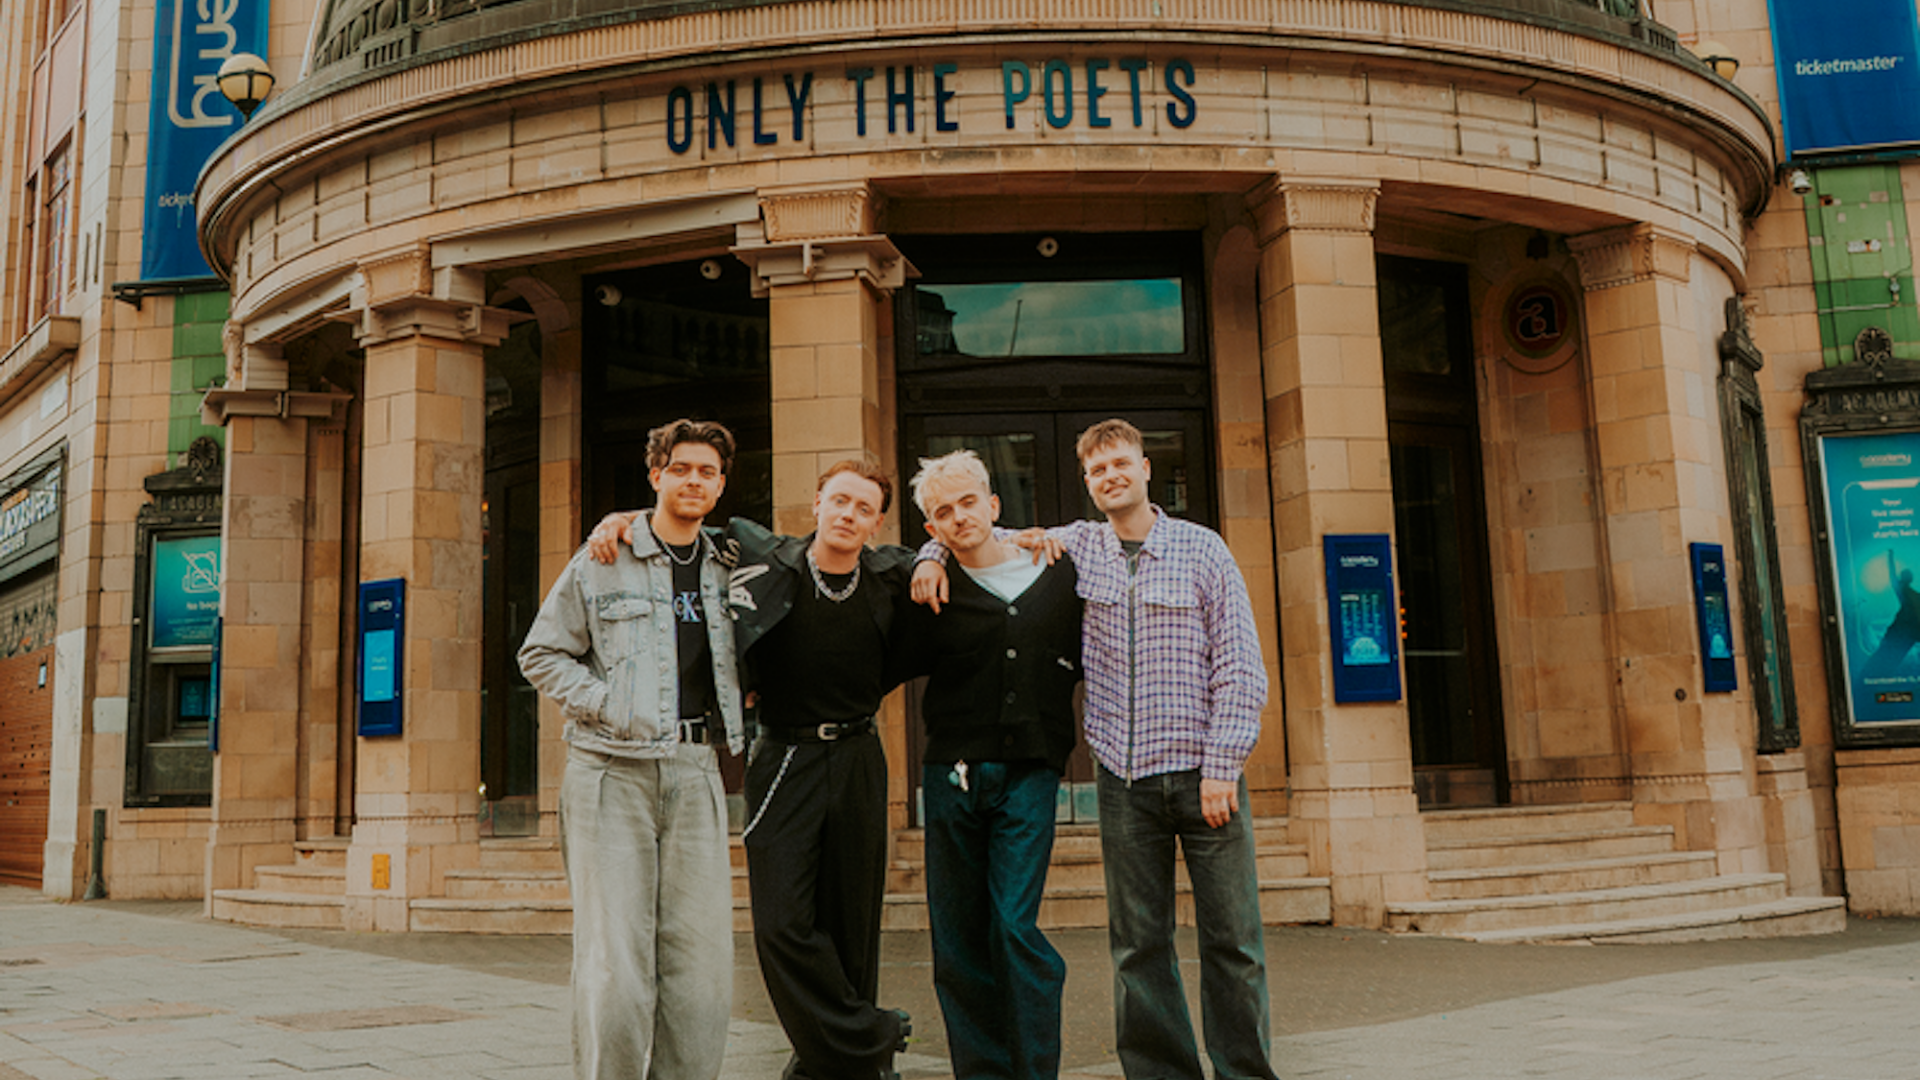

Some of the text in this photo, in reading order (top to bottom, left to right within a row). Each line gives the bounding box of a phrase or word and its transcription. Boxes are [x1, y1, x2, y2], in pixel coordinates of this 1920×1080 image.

[667, 58, 1197, 154] ONLY THE POETS
